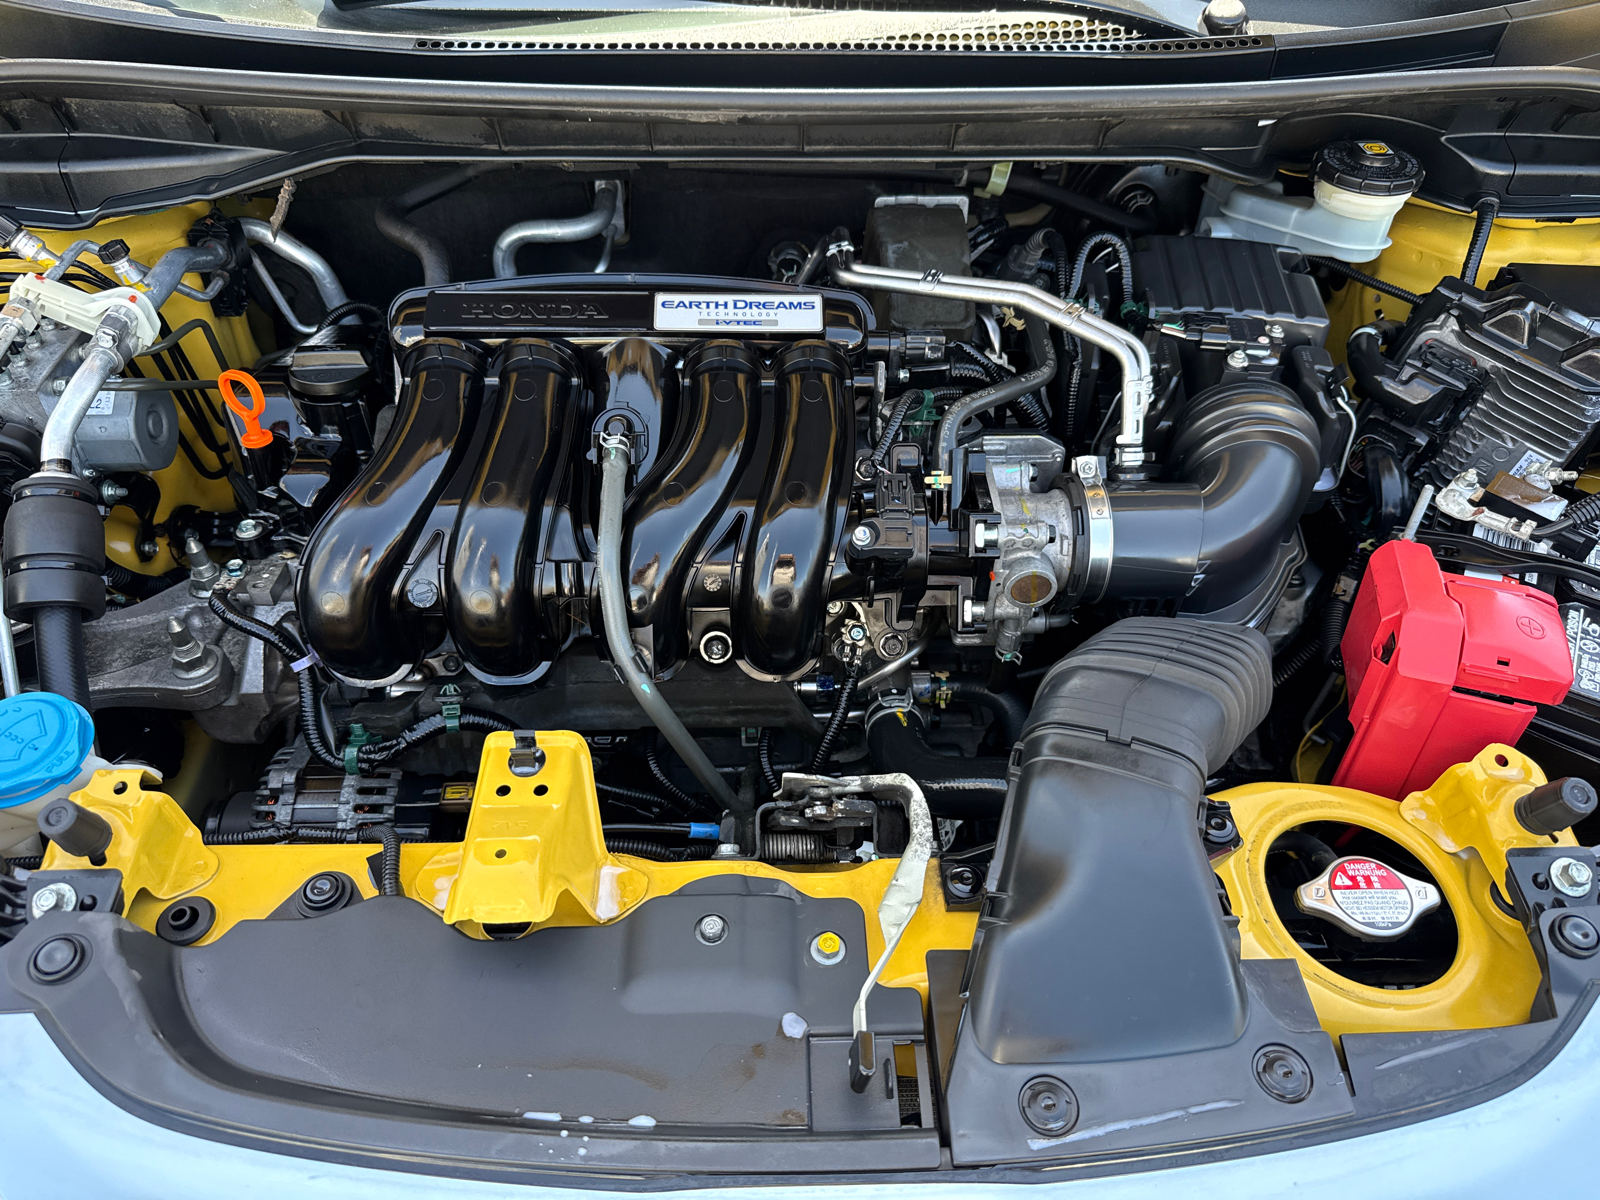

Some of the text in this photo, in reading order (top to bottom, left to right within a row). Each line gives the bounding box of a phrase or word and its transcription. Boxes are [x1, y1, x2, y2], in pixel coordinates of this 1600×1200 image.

[461, 303, 609, 319] HONDA
[661, 299, 816, 310] EARTH DREAMS
[46, 750, 74, 773] PULL
